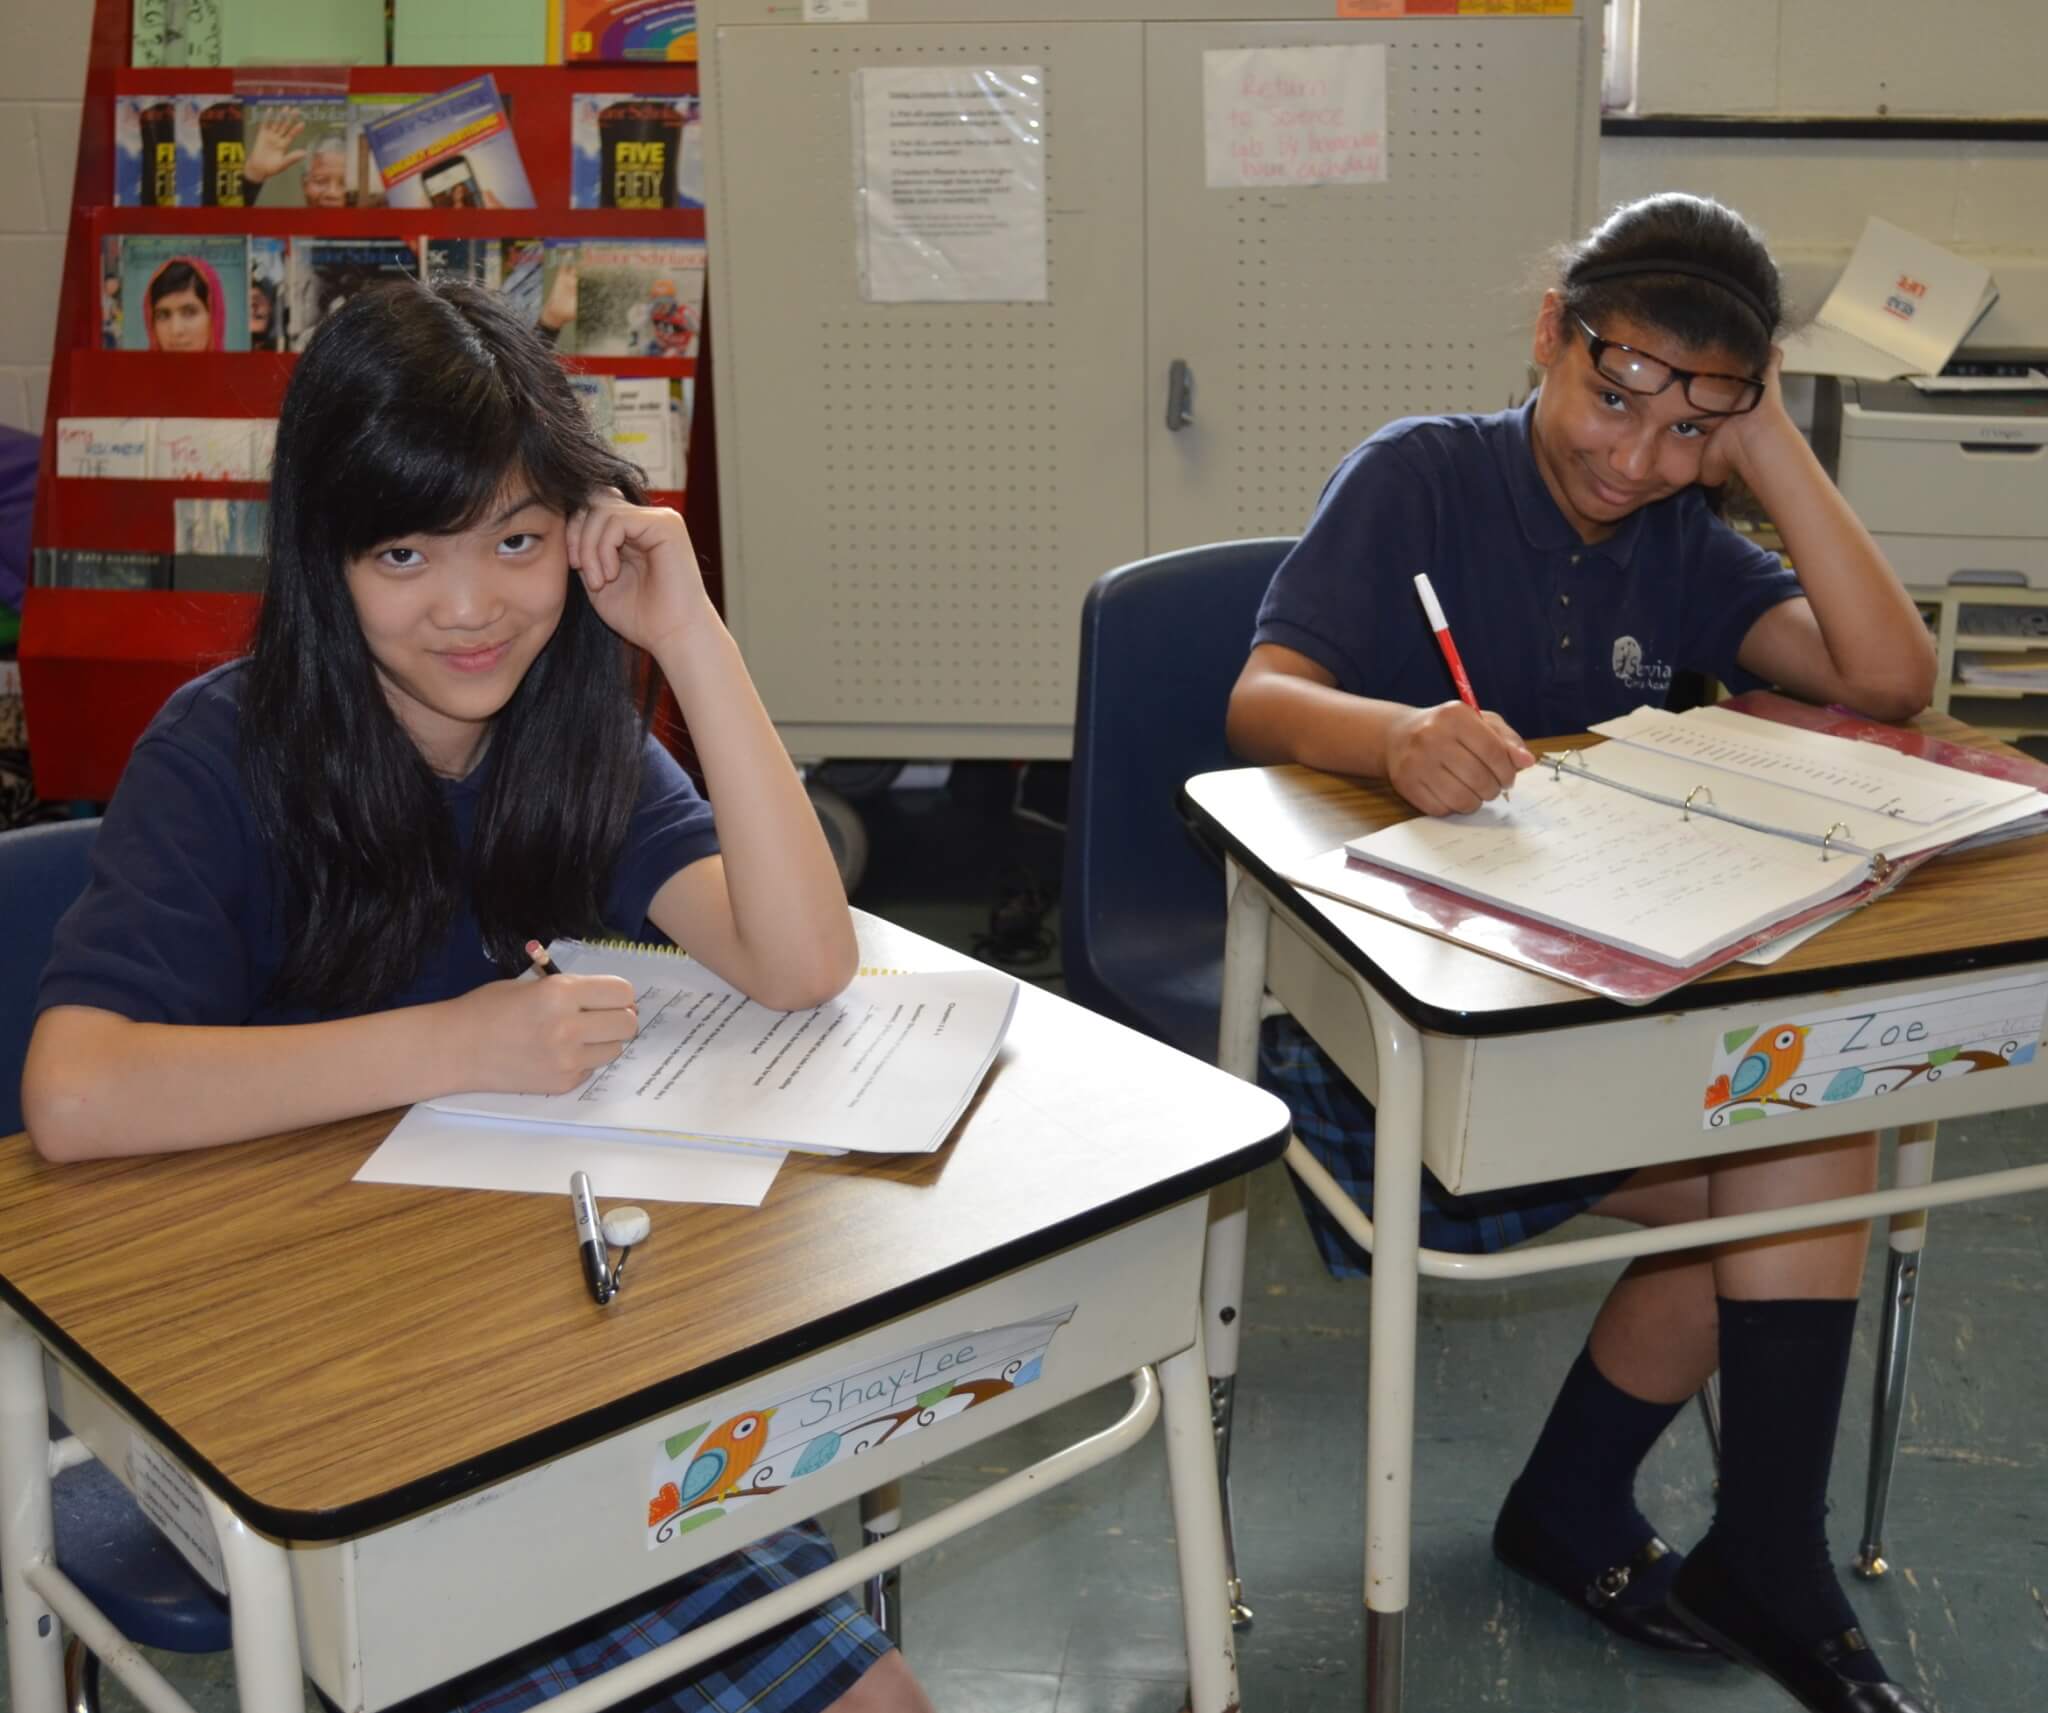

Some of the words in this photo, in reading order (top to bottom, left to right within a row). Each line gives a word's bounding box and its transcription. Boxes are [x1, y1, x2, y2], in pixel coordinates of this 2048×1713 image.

[616, 142, 664, 163] FIVE
[615, 171, 662, 198] FIFTY
[1839, 1013, 1929, 1053] Zoe
[799, 1344, 978, 1428] Shay-Lee
